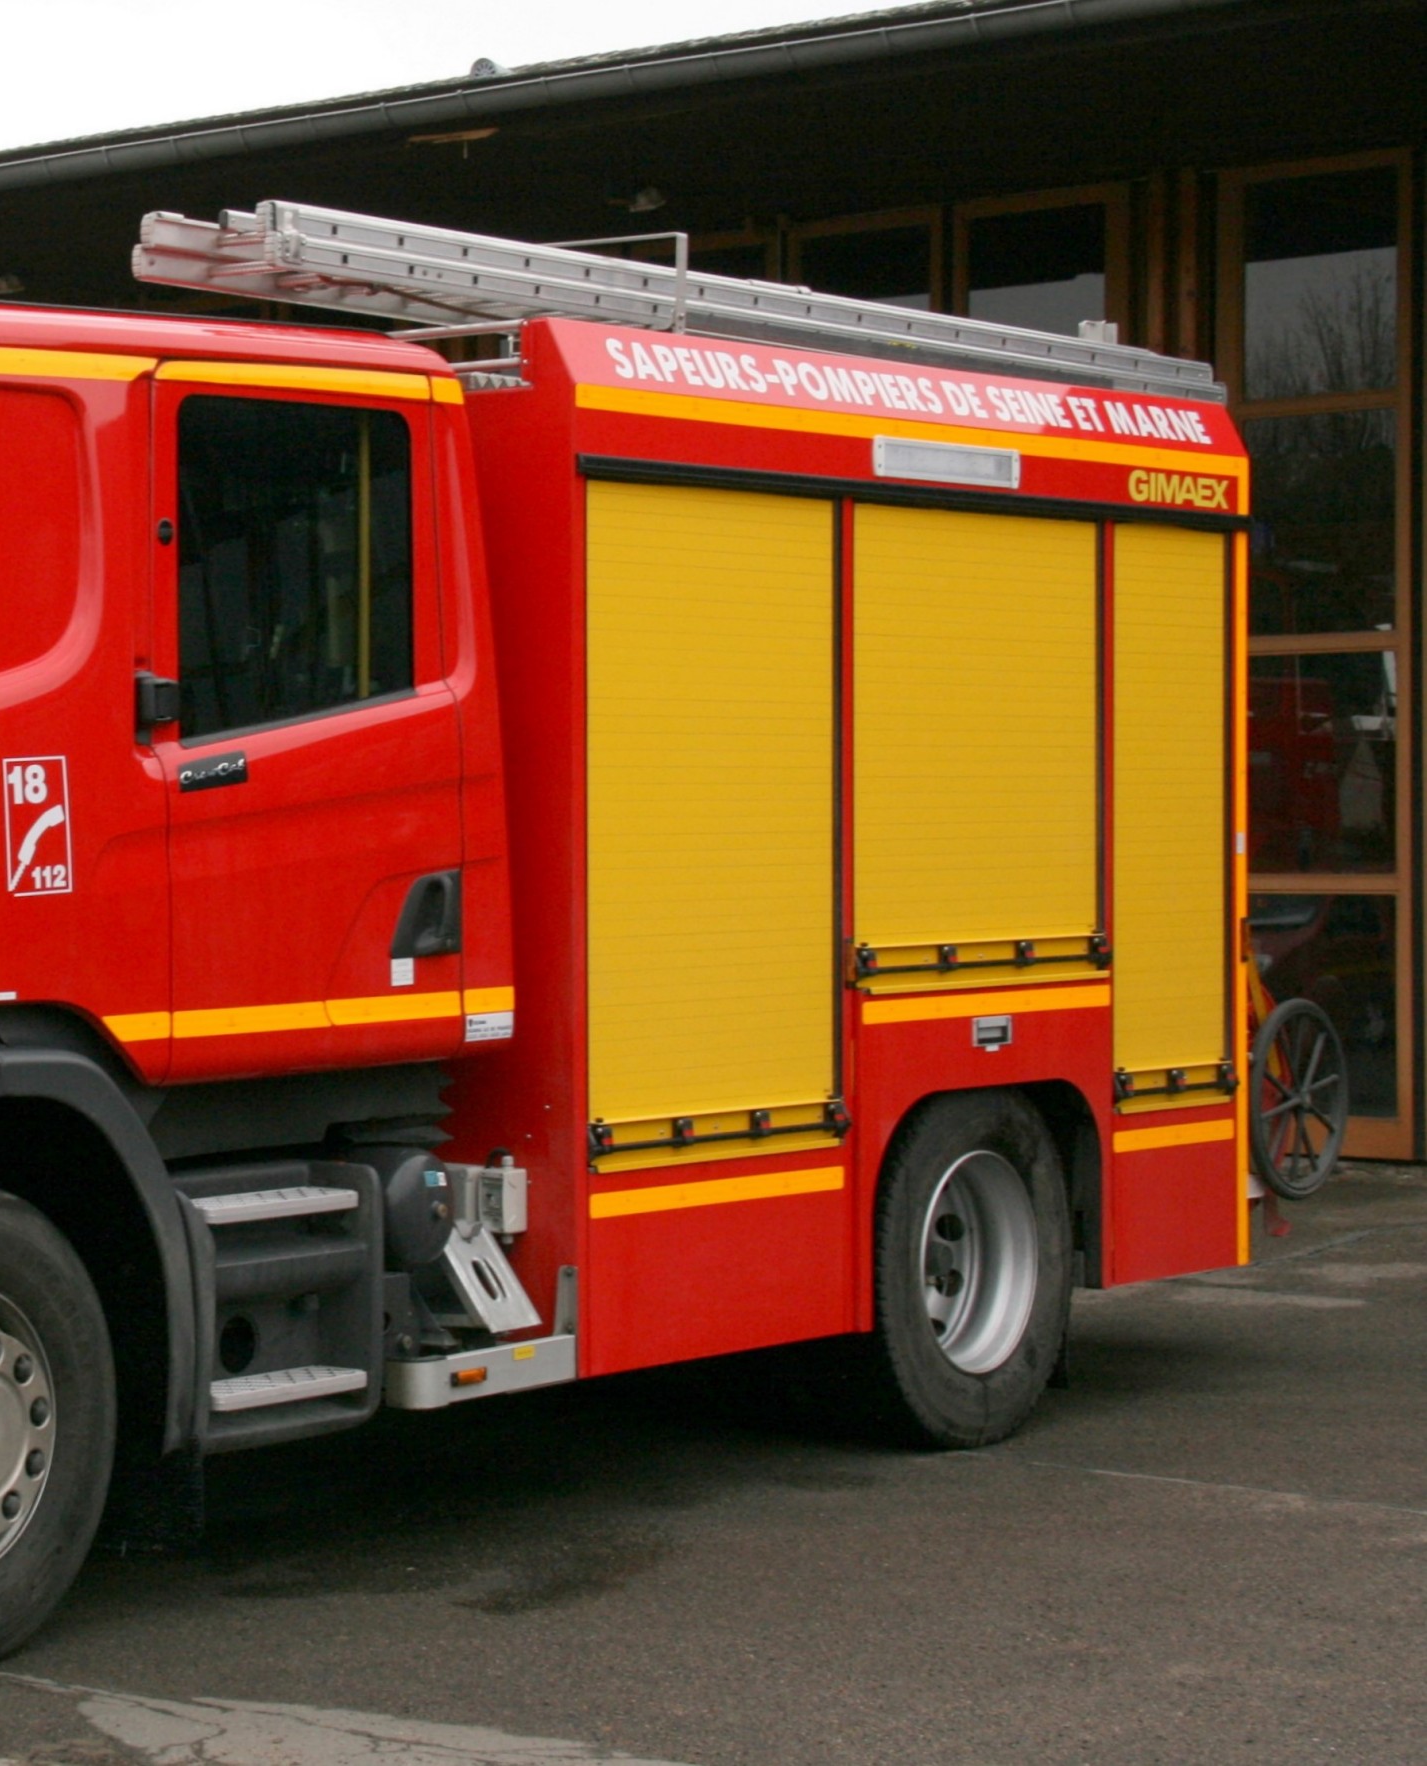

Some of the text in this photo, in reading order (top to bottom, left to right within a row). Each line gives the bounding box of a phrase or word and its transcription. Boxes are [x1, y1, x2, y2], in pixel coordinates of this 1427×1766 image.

[605, 337, 1213, 445] SAPEURS-POMPIERS DE SEINE ET MARNE
[1128, 469, 1229, 510] GIMAEX
[7, 764, 48, 804] 18
[31, 864, 67, 889] 112
